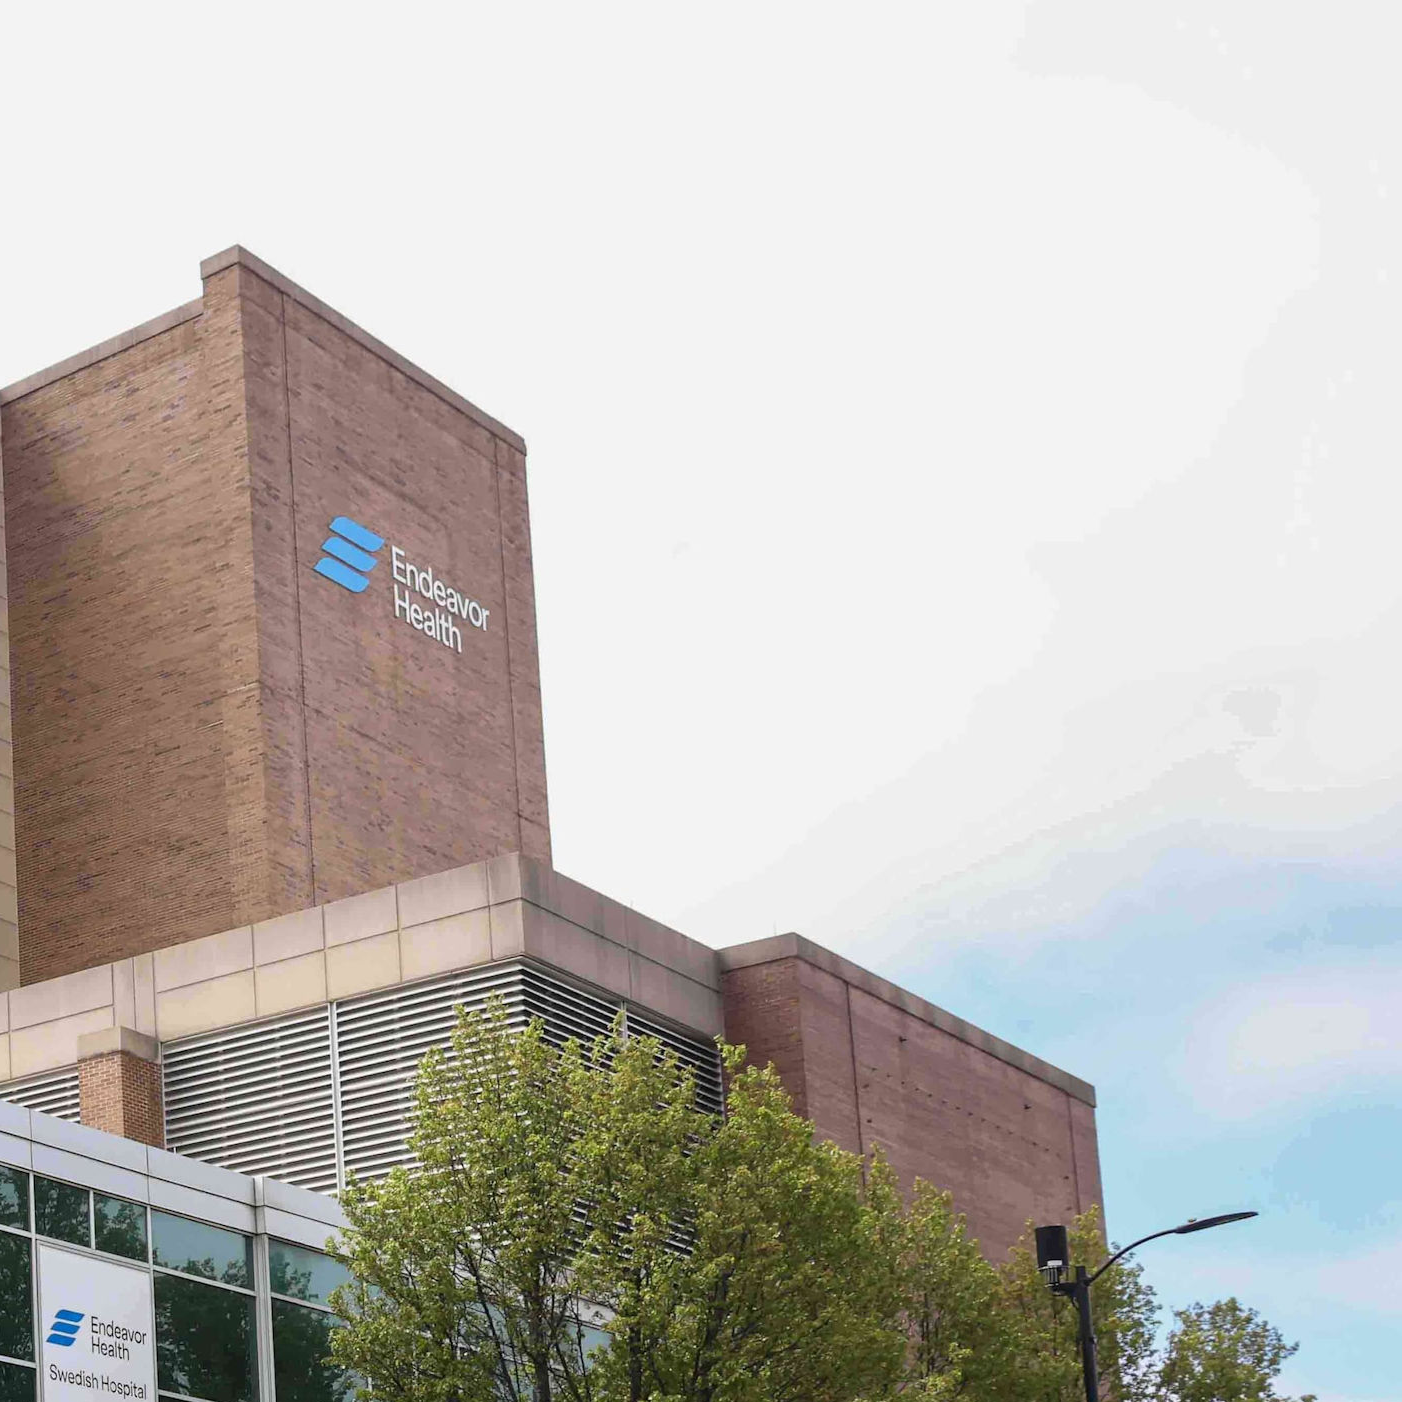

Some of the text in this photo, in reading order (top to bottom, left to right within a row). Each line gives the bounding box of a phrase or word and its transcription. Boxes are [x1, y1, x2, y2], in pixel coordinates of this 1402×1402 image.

[392, 545, 490, 631] Endeavor
[394, 583, 462, 653] Health
[91, 1316, 147, 1344] Endeavor
[91, 1336, 130, 1360] Health
[49, 1364, 147, 1400] Swedish Hospital
